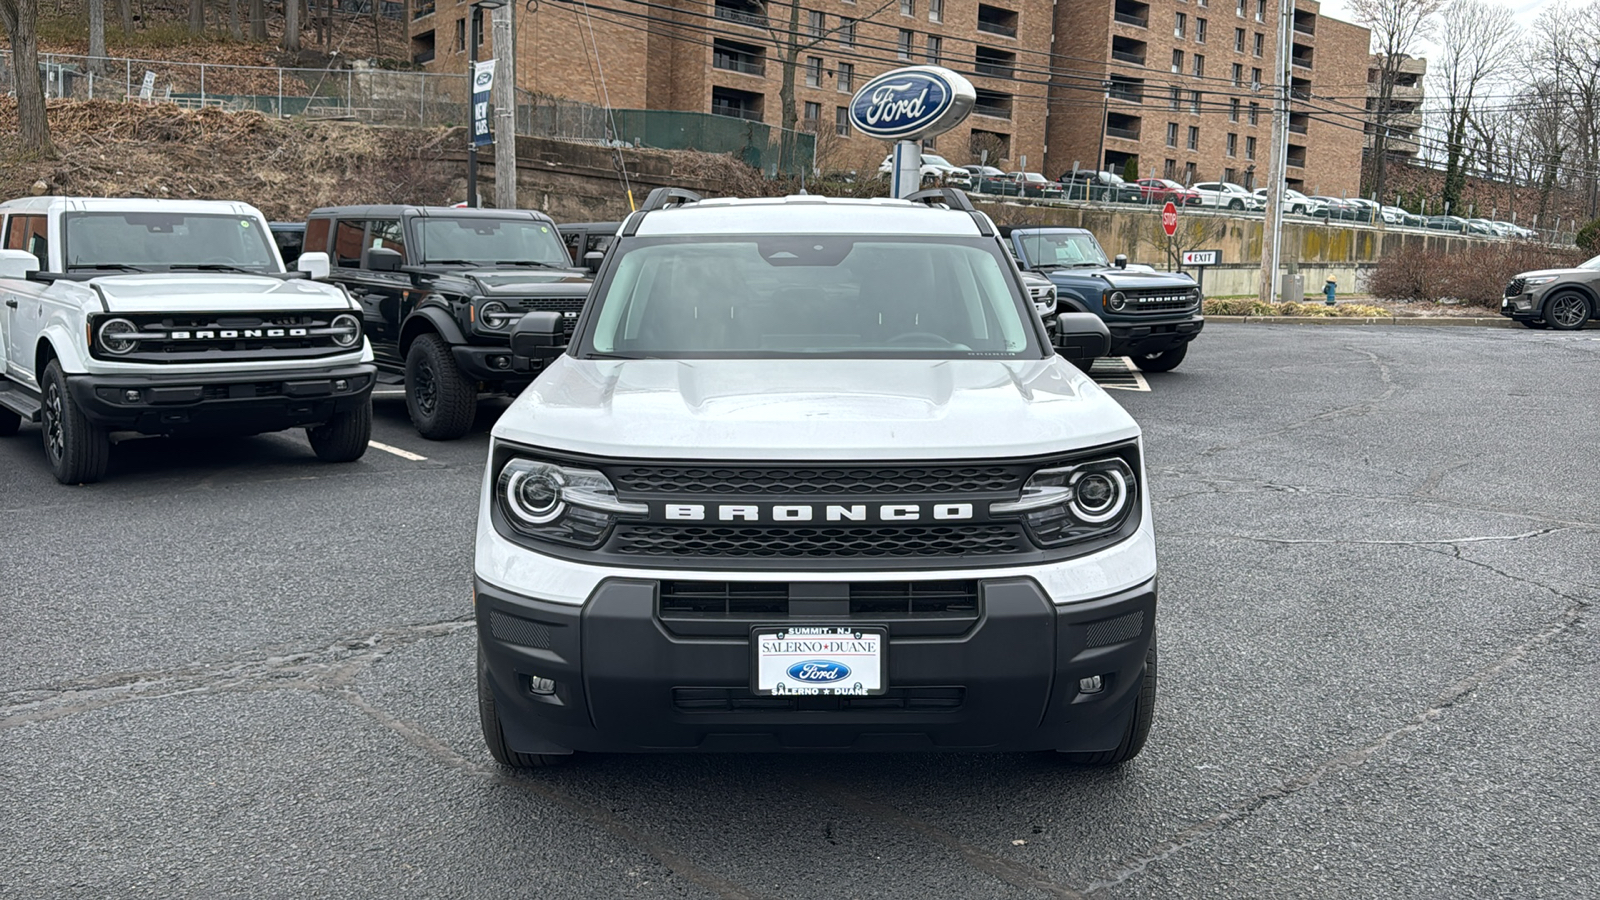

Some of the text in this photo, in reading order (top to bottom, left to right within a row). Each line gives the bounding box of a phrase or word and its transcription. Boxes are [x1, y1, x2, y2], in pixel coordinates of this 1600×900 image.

[866, 82, 929, 125] Ford
[475, 101, 487, 120] NEW
[475, 119, 489, 135] CARS
[1163, 213, 1176, 225] STOP
[1193, 253, 1212, 263] EXIT
[1138, 295, 1186, 303] BRONCO
[171, 328, 307, 340] BRONCO
[665, 503, 973, 521] BRONCO
[837, 627, 851, 635] NJ
[762, 641, 876, 653] SALERNO DUANE
[799, 663, 838, 680] Ford
[771, 687, 868, 696] SALERNO DUANE
